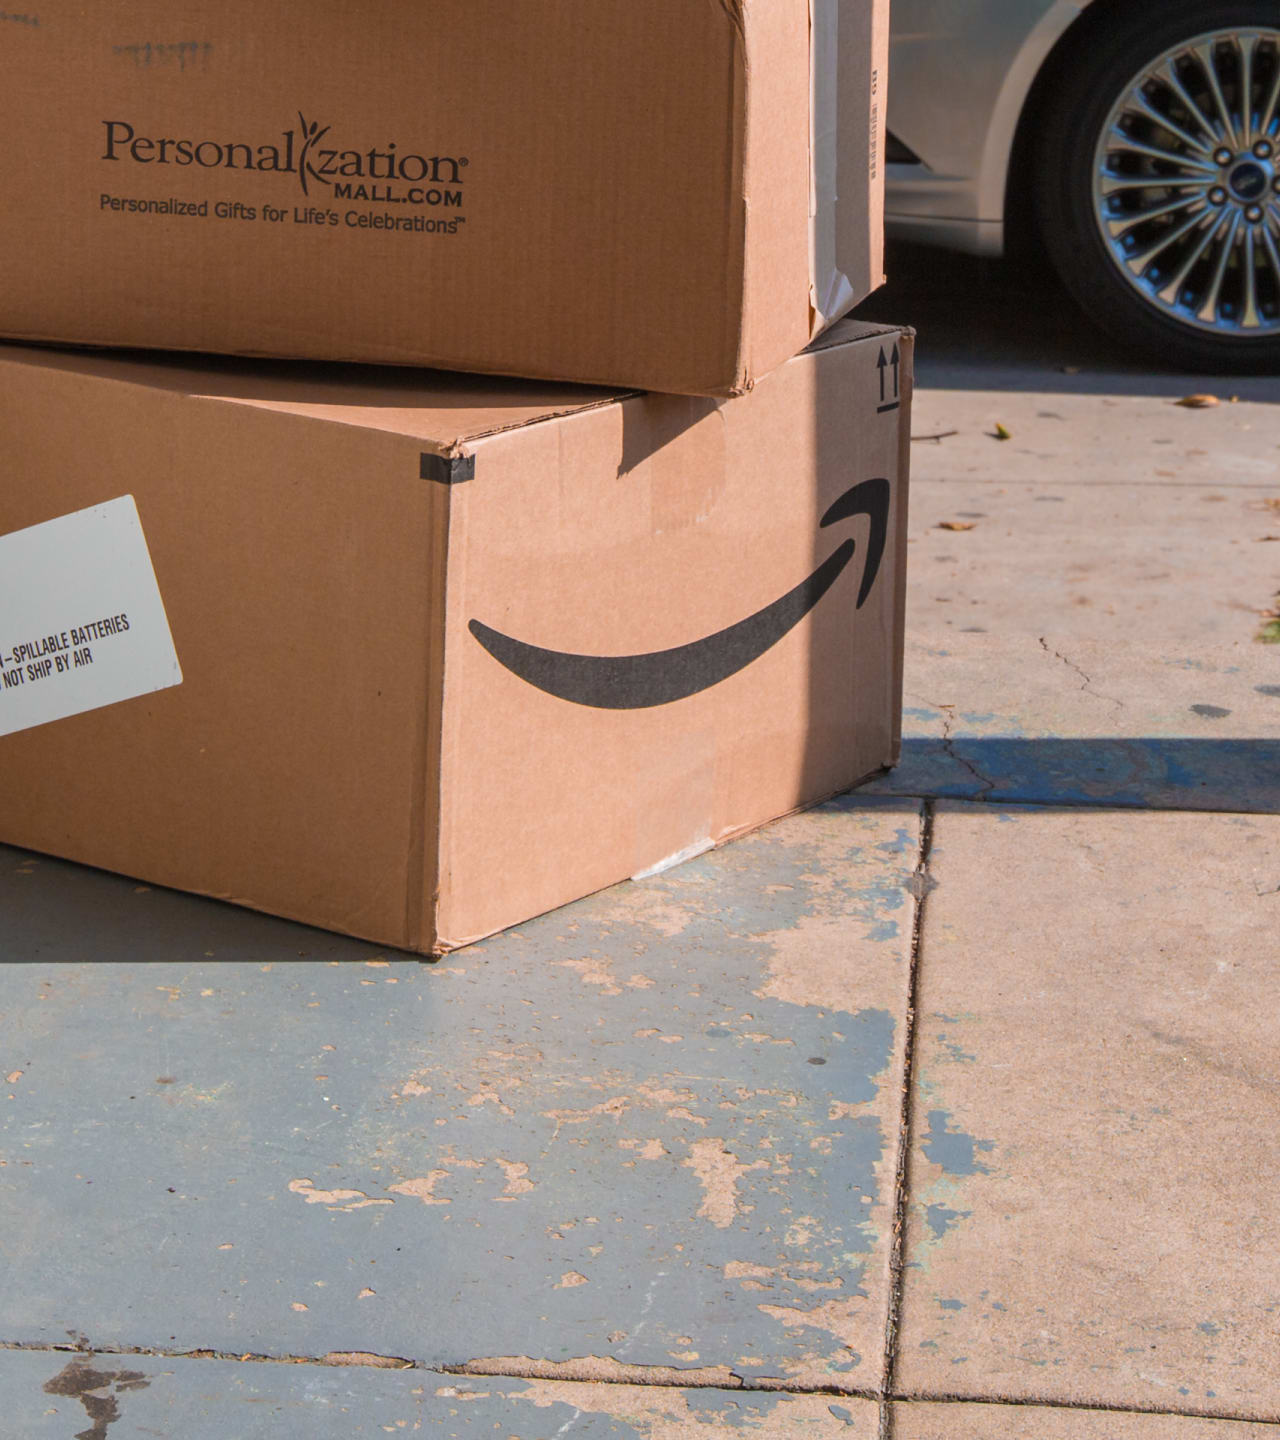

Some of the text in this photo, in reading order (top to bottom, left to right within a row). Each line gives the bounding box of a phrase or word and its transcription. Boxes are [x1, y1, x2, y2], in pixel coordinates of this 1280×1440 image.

[100, 194, 208, 218] Personalized
[214, 201, 257, 221] Gifts
[262, 204, 289, 223] for
[294, 207, 339, 227] Life's
[333, 182, 463, 208] MALL.COM
[70, 613, 130, 646] BATTERIES
[4, 667, 26, 689] NOT
[28, 661, 53, 682] SHIP
[56, 655, 71, 674] BY
[73, 647, 94, 669] AIR
